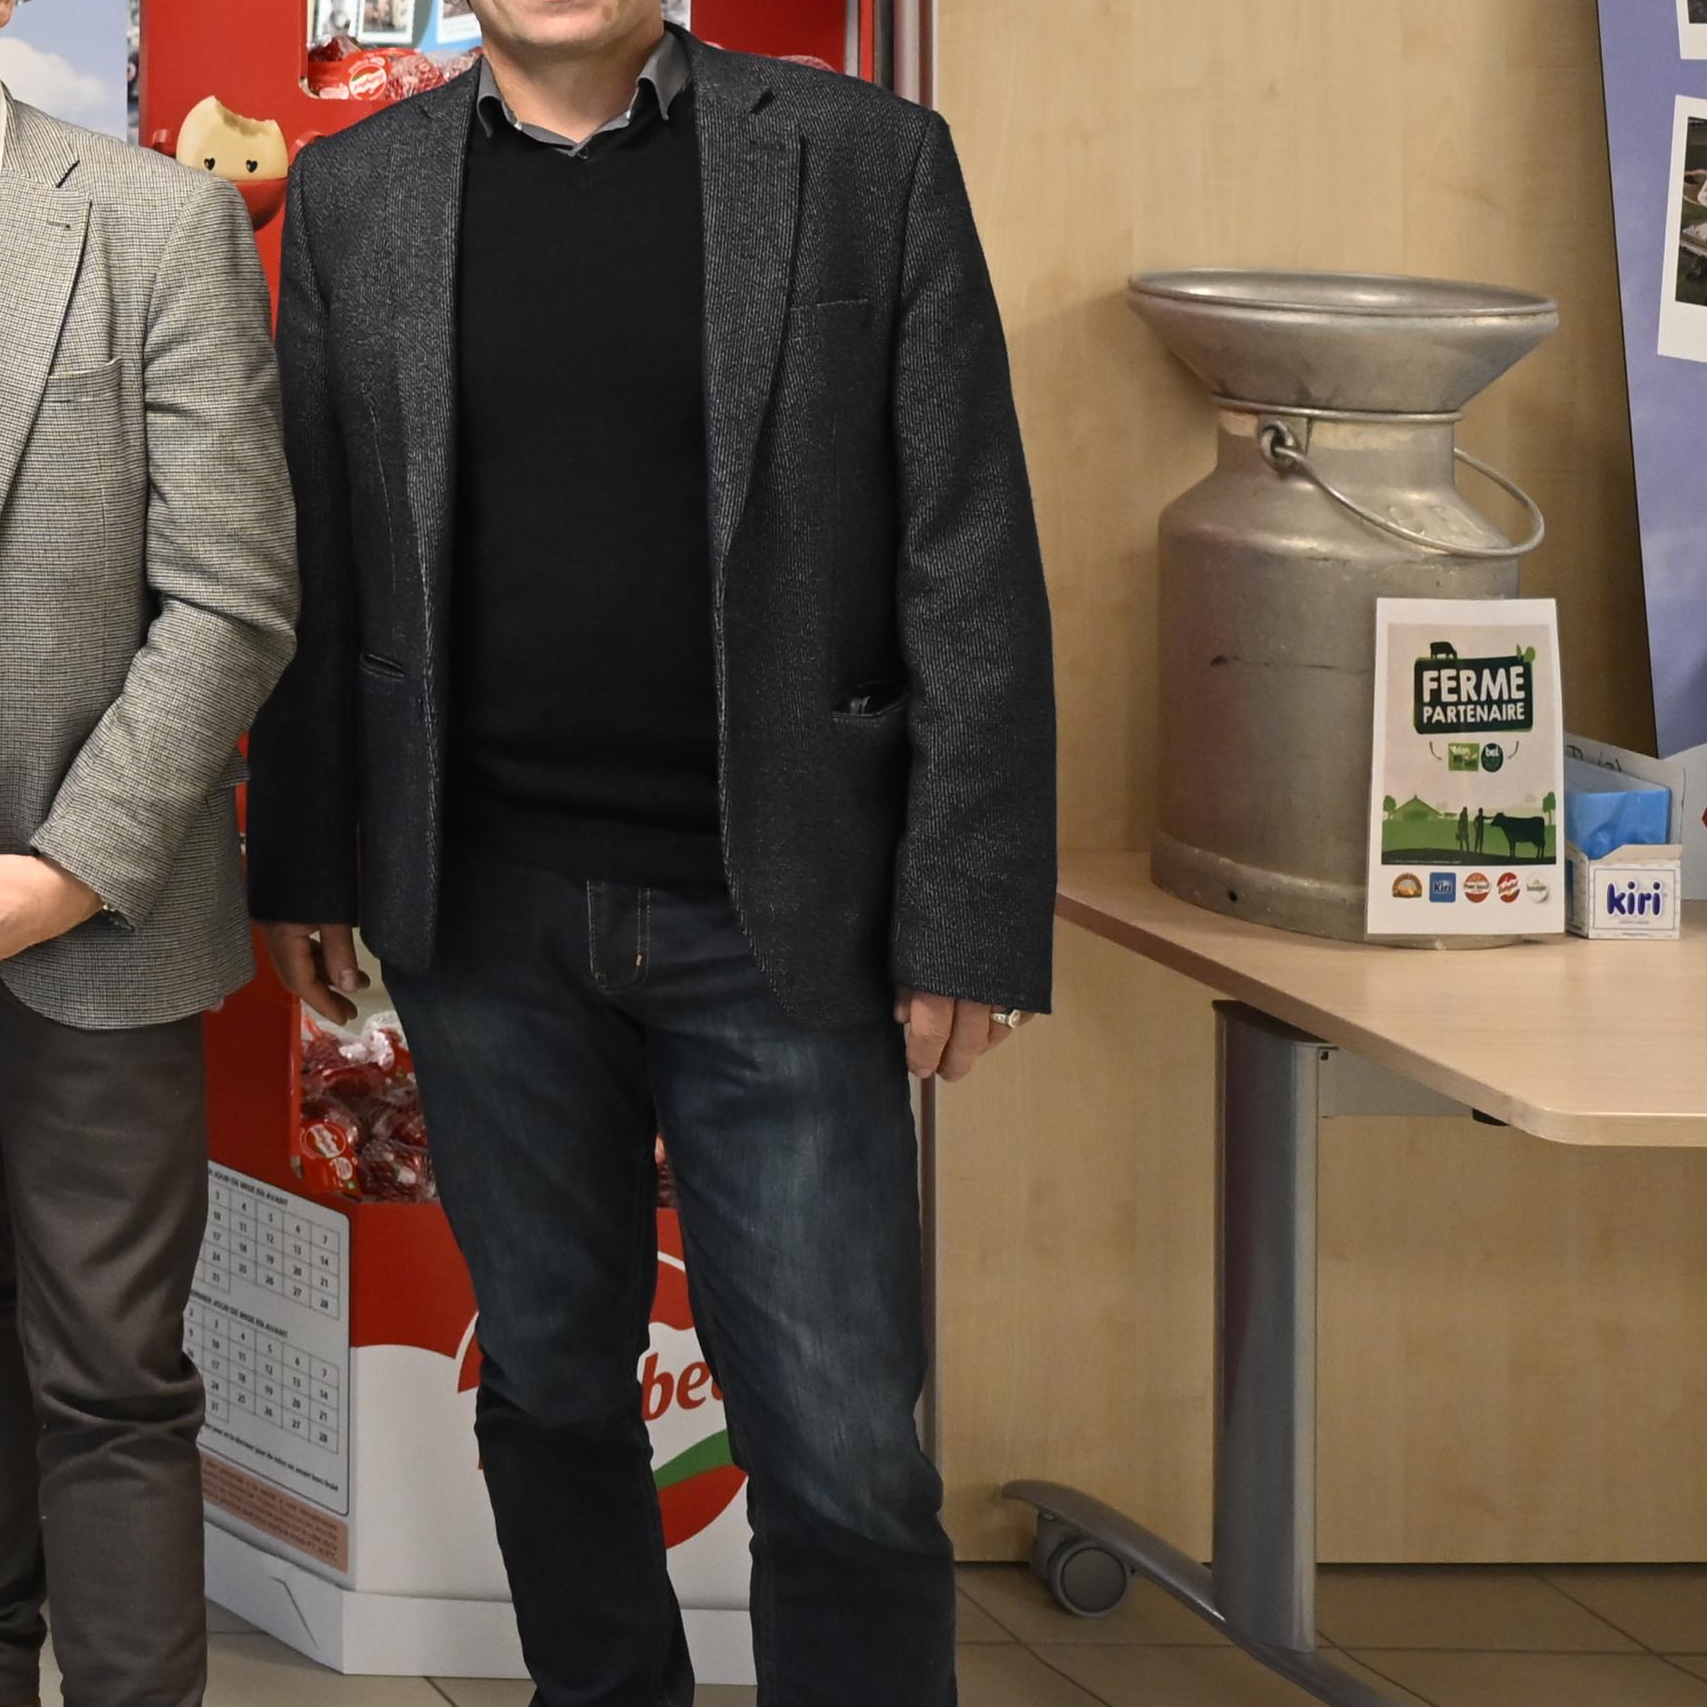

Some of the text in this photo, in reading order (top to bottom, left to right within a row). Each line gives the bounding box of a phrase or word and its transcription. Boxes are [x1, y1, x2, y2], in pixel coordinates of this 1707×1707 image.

[1422, 666, 1525, 703] FERME
[1423, 702, 1525, 724] PARTENAIRE
[1606, 880, 1663, 916] kiri
